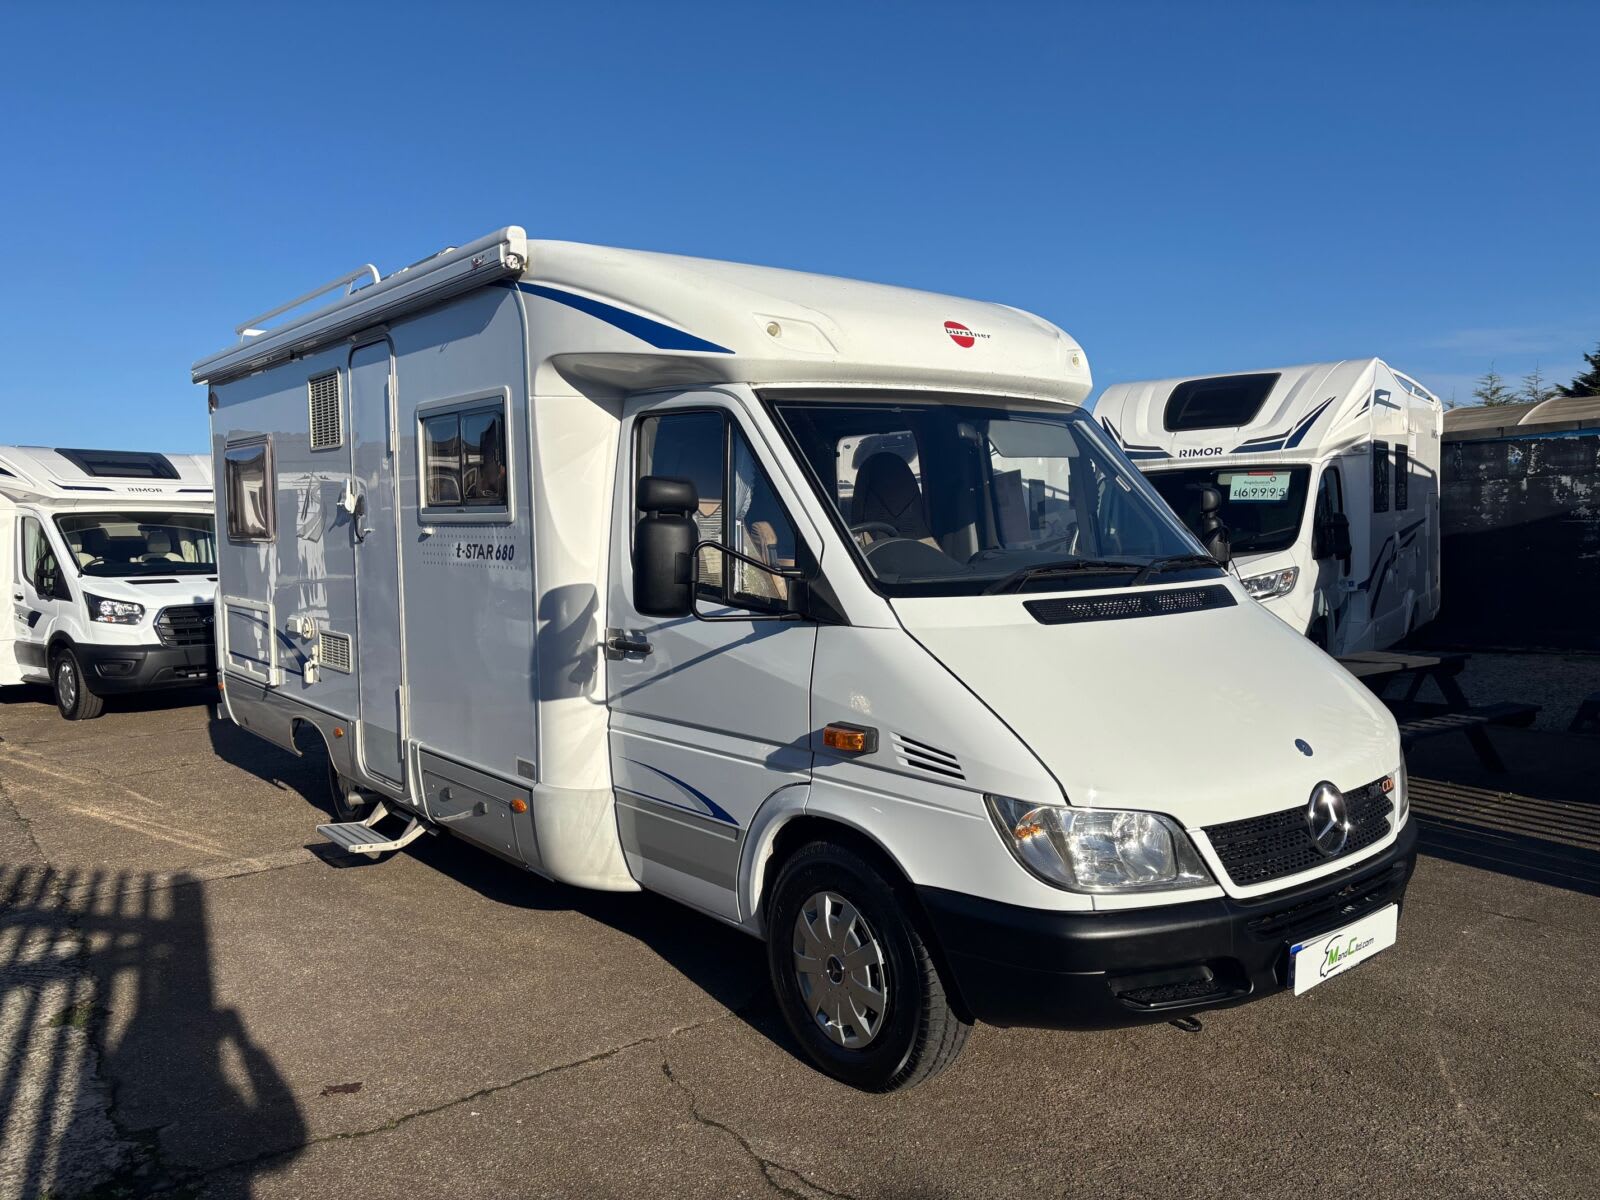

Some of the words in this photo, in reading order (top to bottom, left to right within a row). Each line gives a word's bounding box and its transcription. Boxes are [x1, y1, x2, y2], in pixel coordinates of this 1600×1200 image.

[1179, 447, 1223, 458] RIMOR
[456, 543, 493, 560] t-STAR
[495, 544, 515, 561] 680
